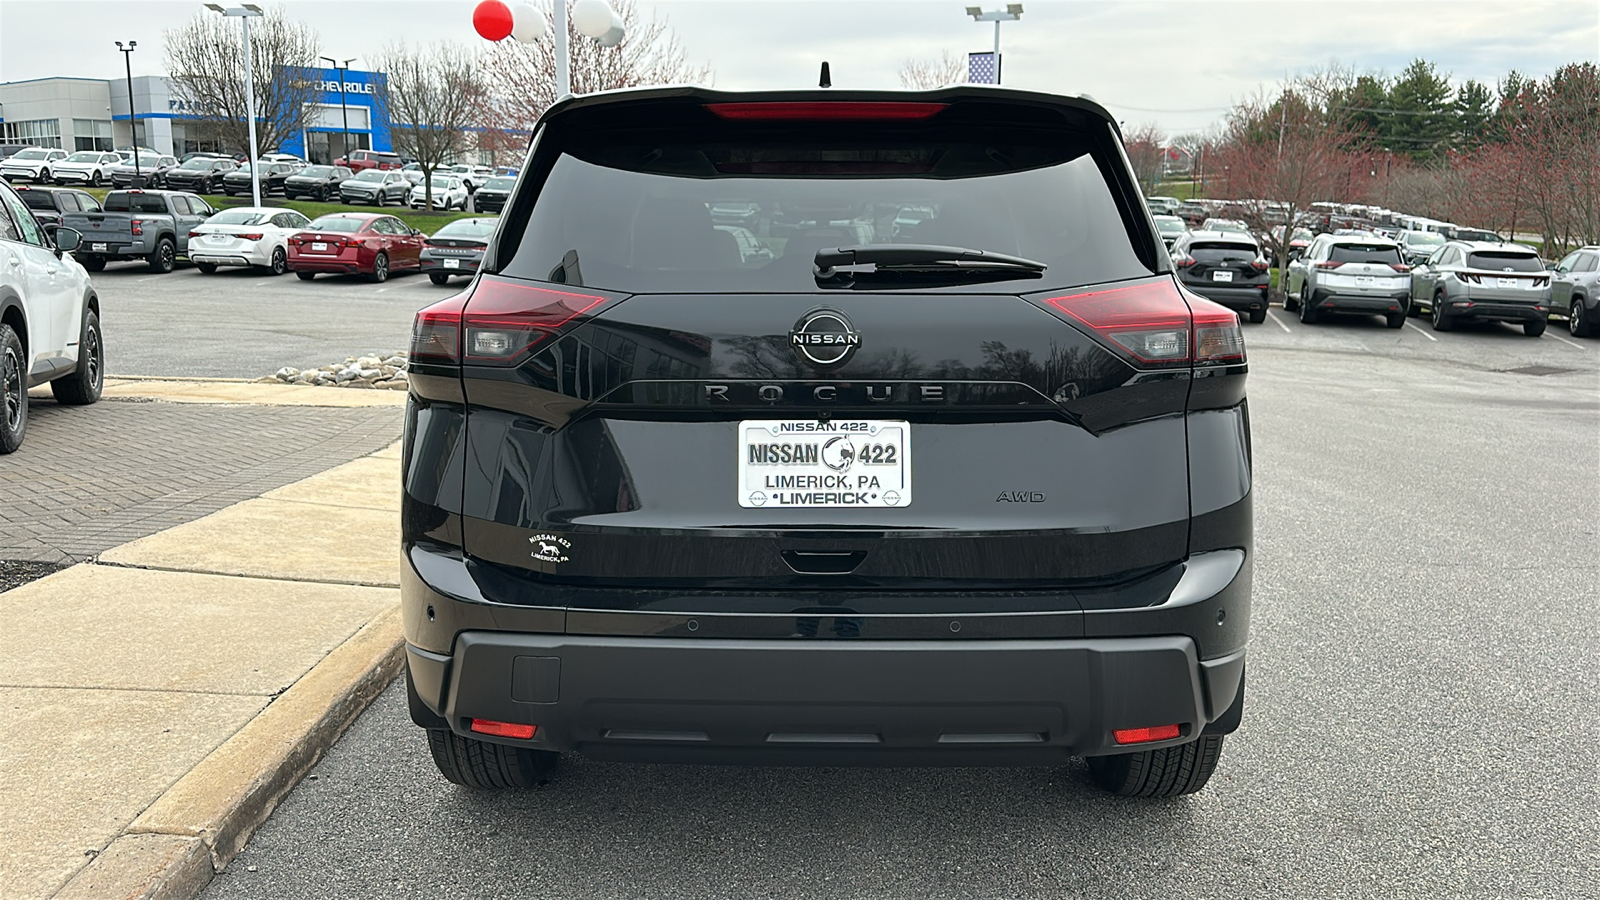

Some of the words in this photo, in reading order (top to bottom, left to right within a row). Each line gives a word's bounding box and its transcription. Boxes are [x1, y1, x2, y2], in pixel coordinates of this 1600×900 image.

[792, 334, 859, 345] NISSAN
[704, 385, 944, 402] ROGUE
[780, 422, 837, 432] NISSAN
[840, 422, 869, 431] 422
[748, 443, 818, 464] NISSAN
[859, 444, 897, 464] 422
[765, 475, 853, 490] LIMERICK,
[858, 475, 881, 488] PA
[779, 492, 870, 505] LIMERICK
[995, 490, 1047, 503] AWD
[528, 533, 557, 544] NISSAN
[557, 537, 572, 549] 422
